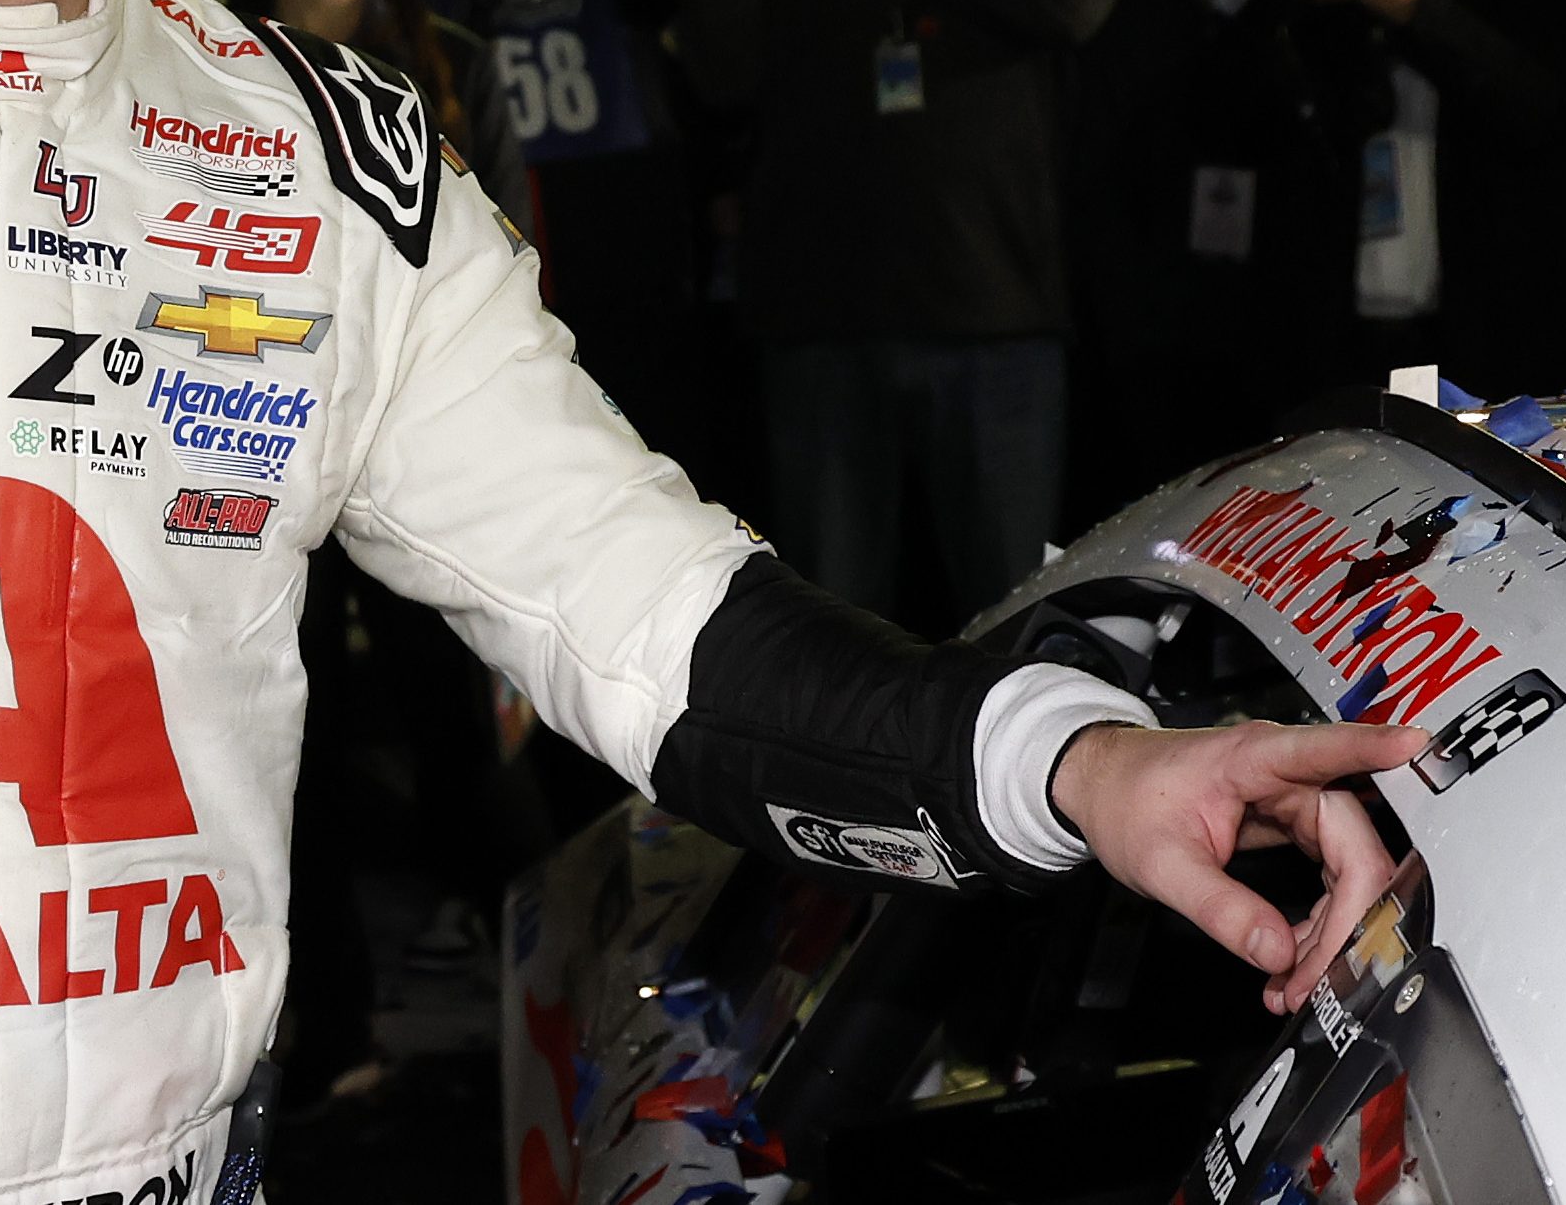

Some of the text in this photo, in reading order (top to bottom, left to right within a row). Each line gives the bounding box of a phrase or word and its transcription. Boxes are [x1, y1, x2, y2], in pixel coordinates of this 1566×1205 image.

[495, 27, 597, 139] 58
[131, 100, 297, 160] Hendrick
[158, 142, 295, 171] MOTORSPORTS
[8, 225, 127, 271] LIBERTY
[8, 255, 128, 288] UNIVERSITY
[106, 337, 142, 386] hp
[147, 367, 317, 429] Hendrick
[51, 427, 147, 461] RELAY
[173, 416, 298, 461] Cars.com
[90, 461, 146, 478] PAYMENTS
[167, 492, 270, 535] ALL-PRO
[168, 530, 260, 550] AUTO RECONDITIONING
[1180, 486, 1368, 614] WILLIAM
